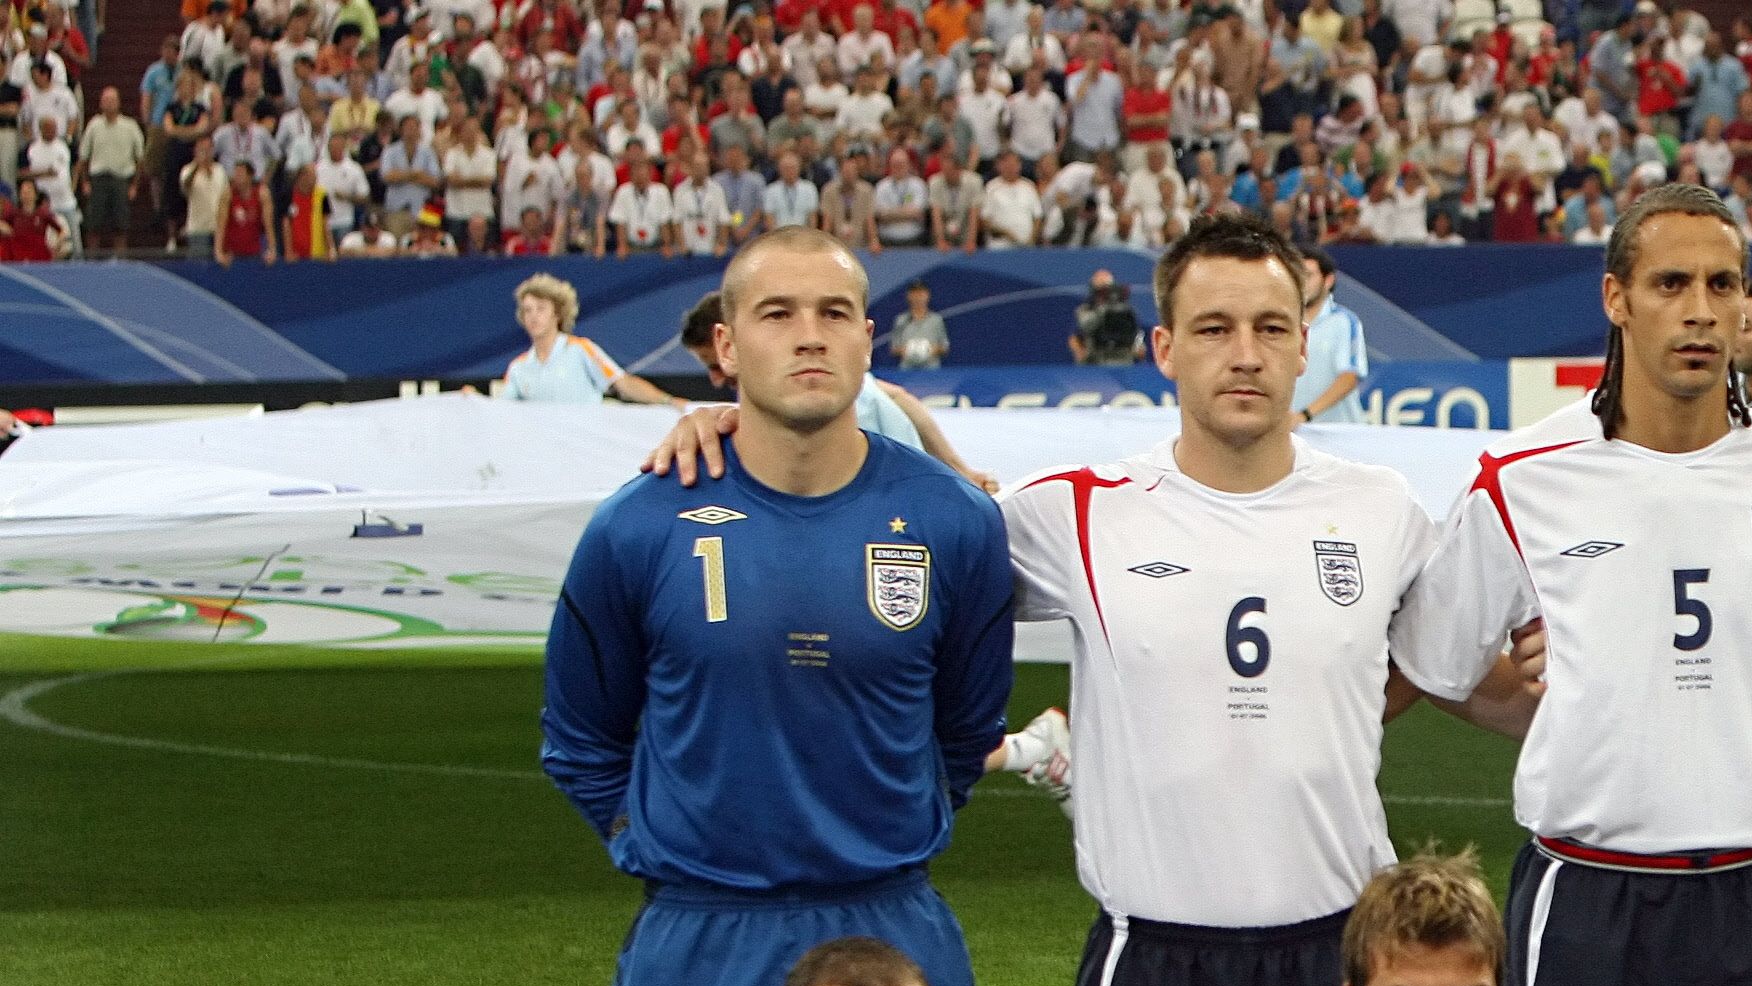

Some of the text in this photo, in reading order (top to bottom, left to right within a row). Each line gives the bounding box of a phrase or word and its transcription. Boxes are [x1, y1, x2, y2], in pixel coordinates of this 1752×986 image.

[692, 536, 728, 623] 1
[1673, 569, 1713, 651] 5
[1225, 596, 1270, 677] 6
